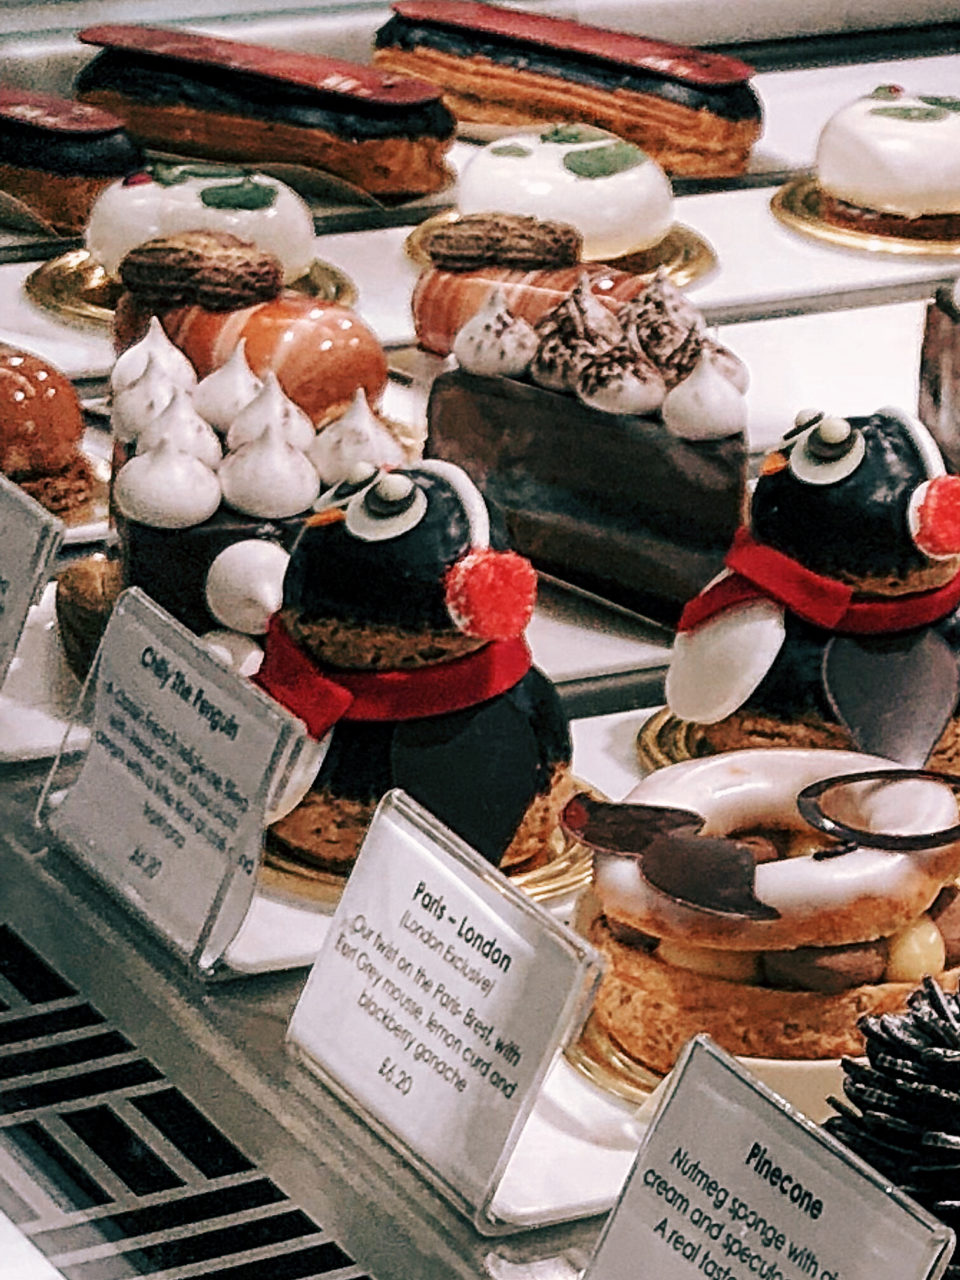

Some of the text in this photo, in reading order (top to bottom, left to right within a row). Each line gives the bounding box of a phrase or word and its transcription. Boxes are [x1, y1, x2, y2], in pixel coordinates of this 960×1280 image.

[400, 910, 496, 997] (London Exclusive)
[412, 881, 446, 921] Paris
[457, 917, 512, 973] London
[334, 933, 518, 1099] Earl Grey mousse, lemon curd and
[352, 914, 374, 939] Our
[374, 931, 398, 962] twist
[397, 958, 413, 977] on
[413, 966, 433, 993] the
[463, 1008, 493, 1046] Brest,
[494, 1036, 521, 1067] with
[357, 988, 467, 1092] blackberry ganache
[378, 1056, 413, 1095] £6.20
[643, 1168, 689, 1215] cream
[690, 1208, 725, 1240] and
[670, 1147, 729, 1209] Nutmeg
[728, 1197, 786, 1250] sponge
[788, 1241, 819, 1277] with
[746, 1142, 824, 1220] Pinecone
[653, 1217, 668, 1239] A
[666, 1229, 702, 1262] real
